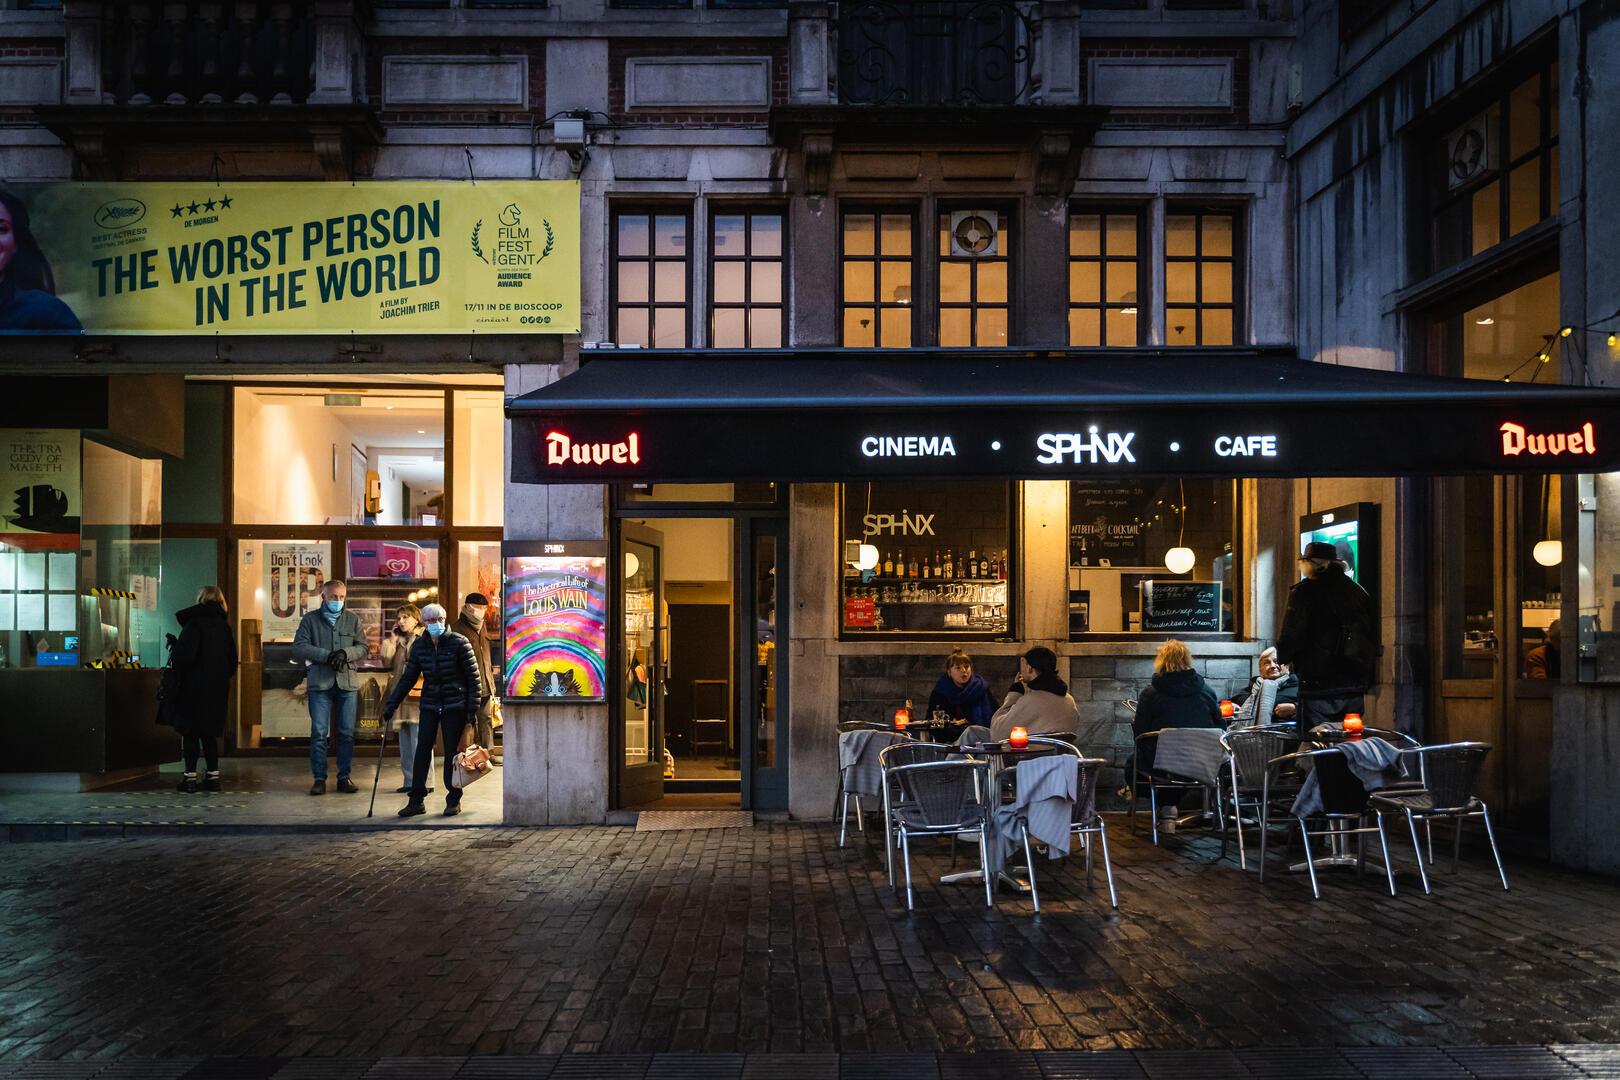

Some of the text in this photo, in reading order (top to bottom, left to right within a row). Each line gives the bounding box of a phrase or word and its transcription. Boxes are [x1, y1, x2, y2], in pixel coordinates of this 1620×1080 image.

[184, 215, 219, 228] DE MORGEN
[498, 227, 529, 239] FILM
[92, 199, 440, 298] THE WORST PERSON
[498, 240, 532, 252] FEST
[498, 254, 535, 265] GENT
[195, 246, 441, 326] IN THE WORLD
[380, 297, 409, 309] A FILM BY
[380, 300, 440, 320] JOACHIM TRIER
[464, 303, 563, 312] 17/11 IN DE BIOSCOOP
[546, 431, 640, 465] Duvel
[861, 436, 956, 457] CINEMA
[1214, 435, 1277, 457] CAFE
[1500, 422, 1596, 455] Duvel
[47, 454, 62, 463] OF
[271, 553, 324, 567] Don't Look
[271, 567, 324, 618] UP
[522, 584, 537, 596] The
[567, 575, 581, 587] Life
[581, 579, 589, 588] of
[523, 588, 588, 617] LOUIS WAIN
